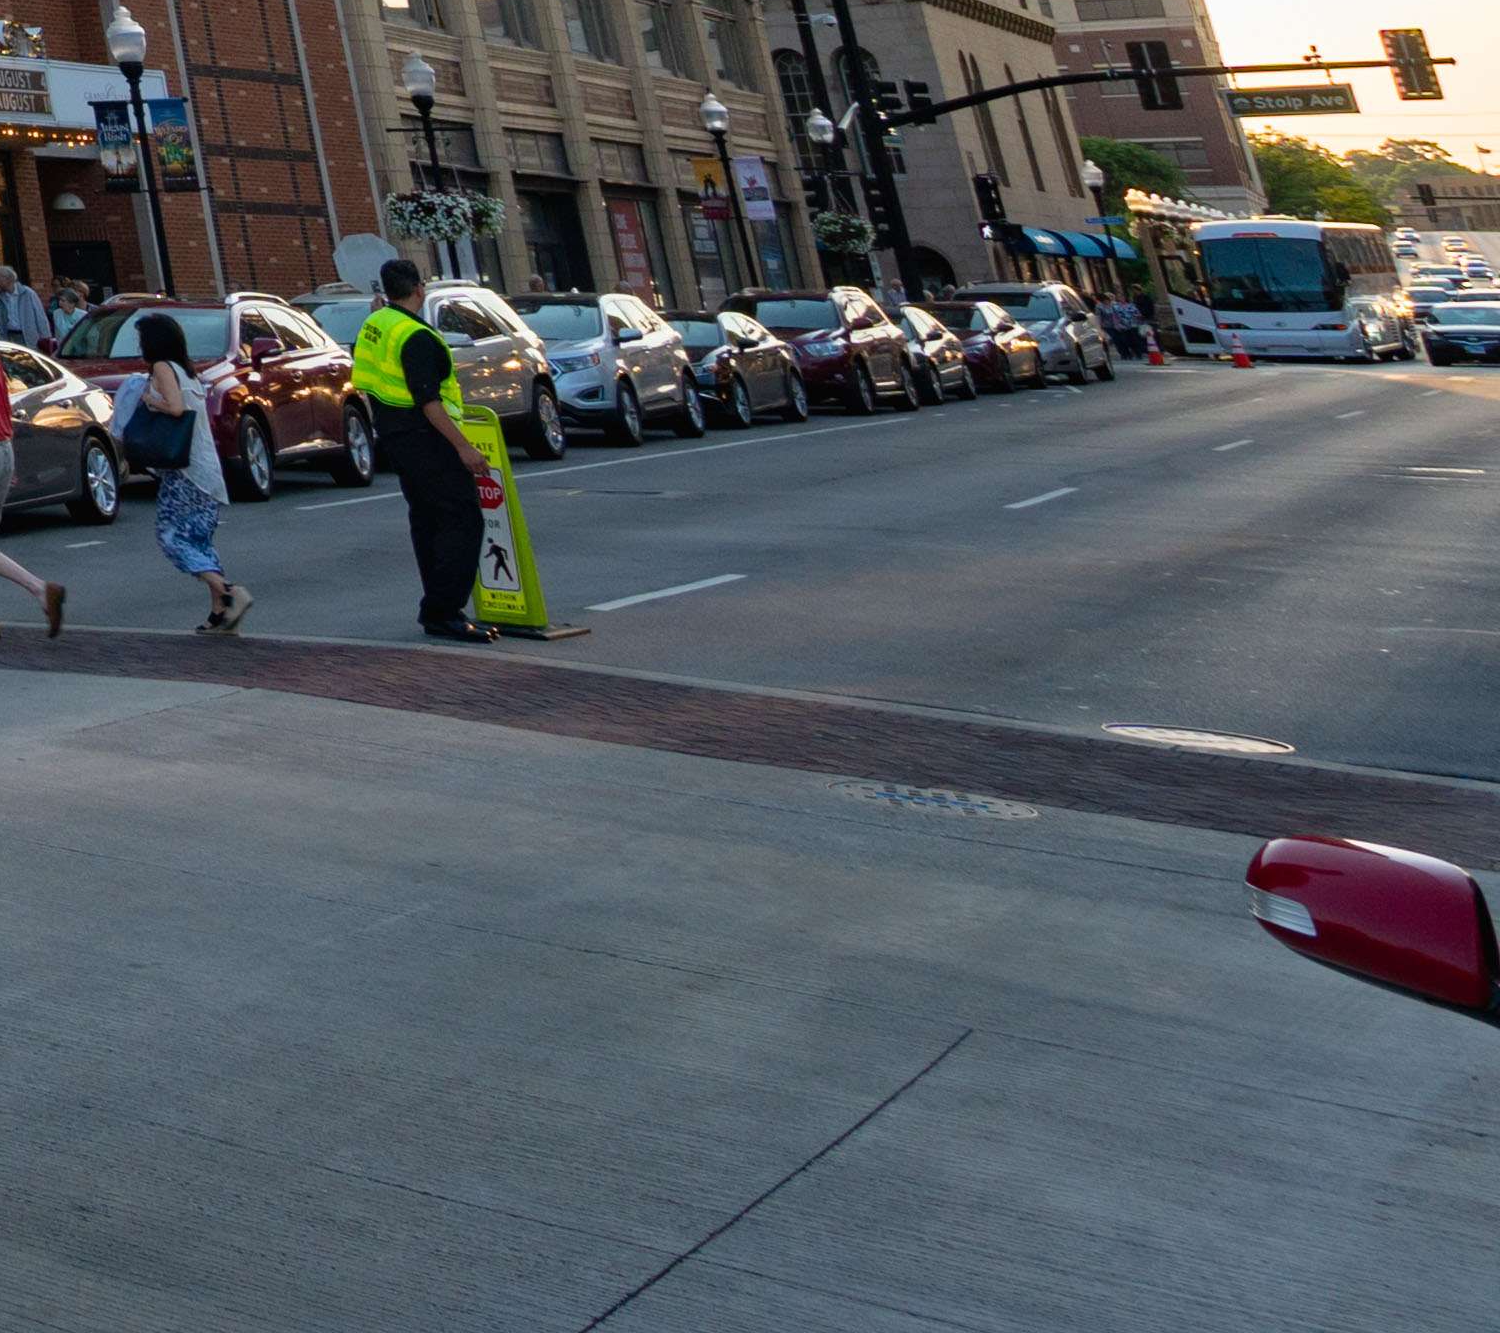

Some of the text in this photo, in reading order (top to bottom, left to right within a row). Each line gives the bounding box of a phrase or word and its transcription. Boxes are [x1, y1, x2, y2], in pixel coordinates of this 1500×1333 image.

[1254, 94, 1344, 110] Stolp Ave
[477, 486, 500, 501] TOP
